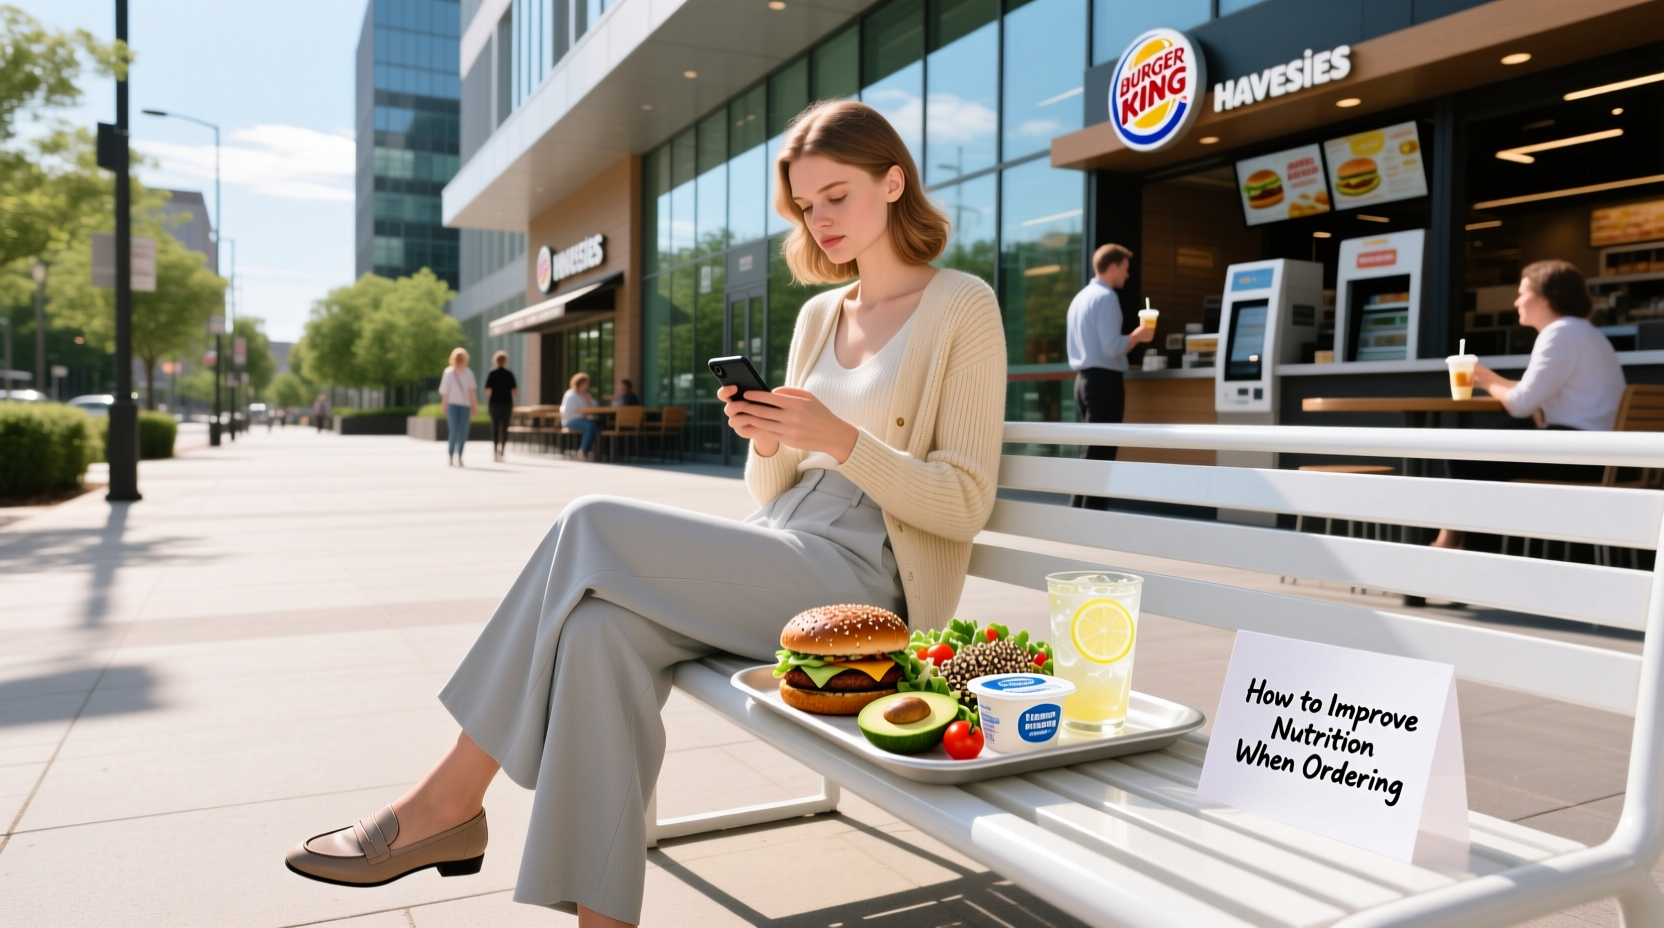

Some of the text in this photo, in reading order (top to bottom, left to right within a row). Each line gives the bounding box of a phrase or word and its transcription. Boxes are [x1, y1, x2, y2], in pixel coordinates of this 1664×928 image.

[1120, 47, 1185, 98] BURGER
[1121, 66, 1187, 127] KING
[1245, 677, 1419, 732] How to Improve
[1270, 716, 1374, 757] Nutrition
[1235, 738, 1404, 807] When Ordering
